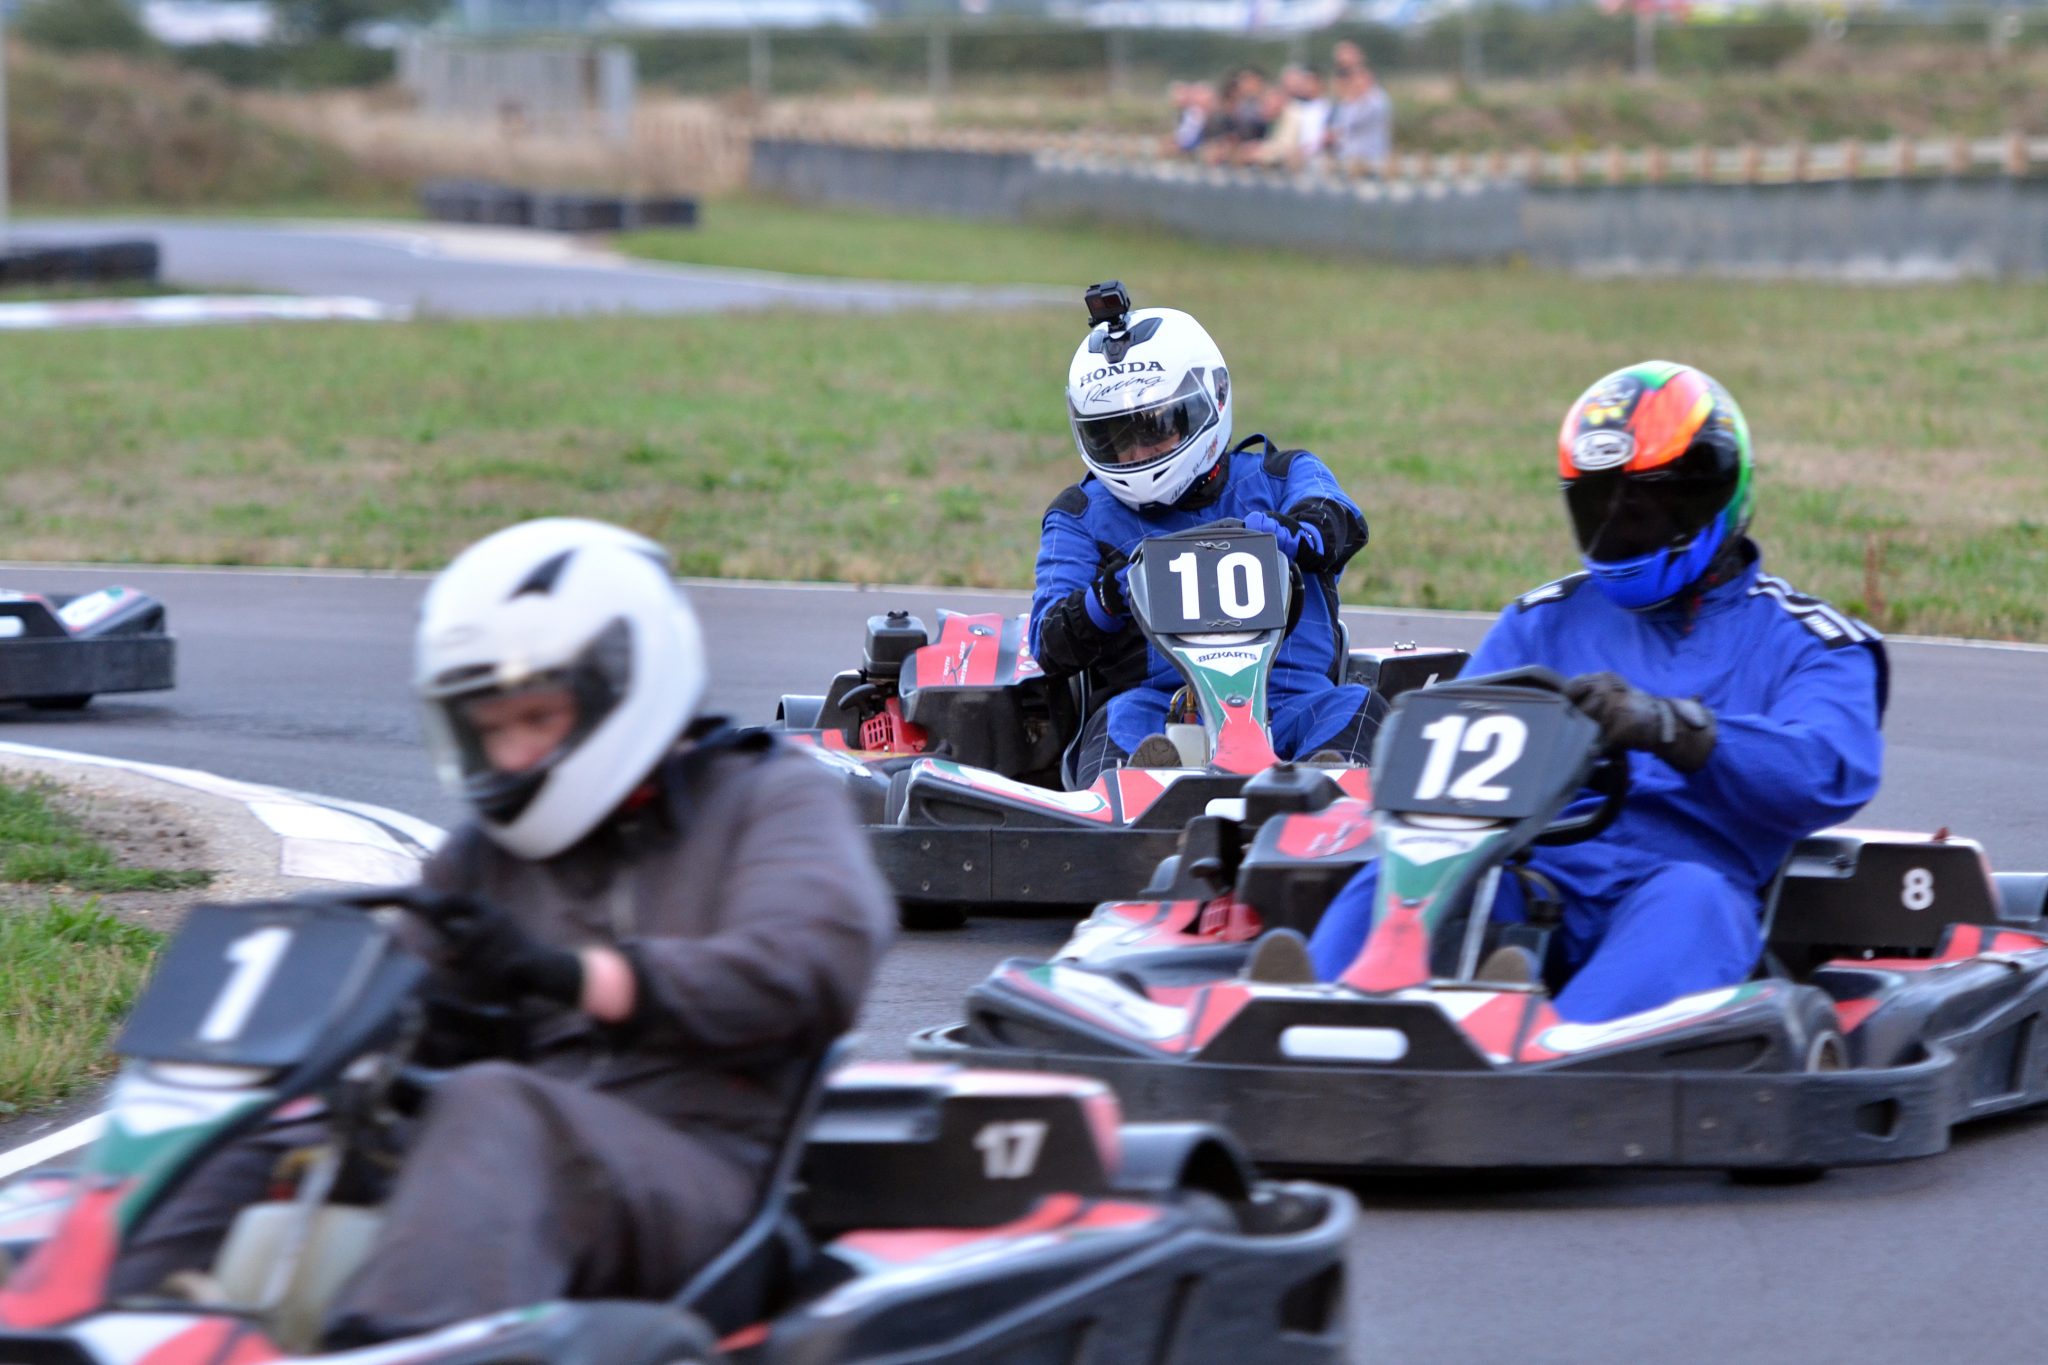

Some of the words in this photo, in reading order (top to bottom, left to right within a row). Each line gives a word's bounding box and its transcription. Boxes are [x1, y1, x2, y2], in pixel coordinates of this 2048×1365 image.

[1080, 361, 1165, 387] HONDA
[1083, 376, 1165, 408] Racing
[1169, 552, 1265, 620] 10
[1197, 651, 1257, 662] BIZKARTS
[1413, 714, 1528, 801] 12
[1902, 867, 1934, 910] 8
[199, 926, 293, 1041] 1
[973, 1120, 1048, 1179] 17
